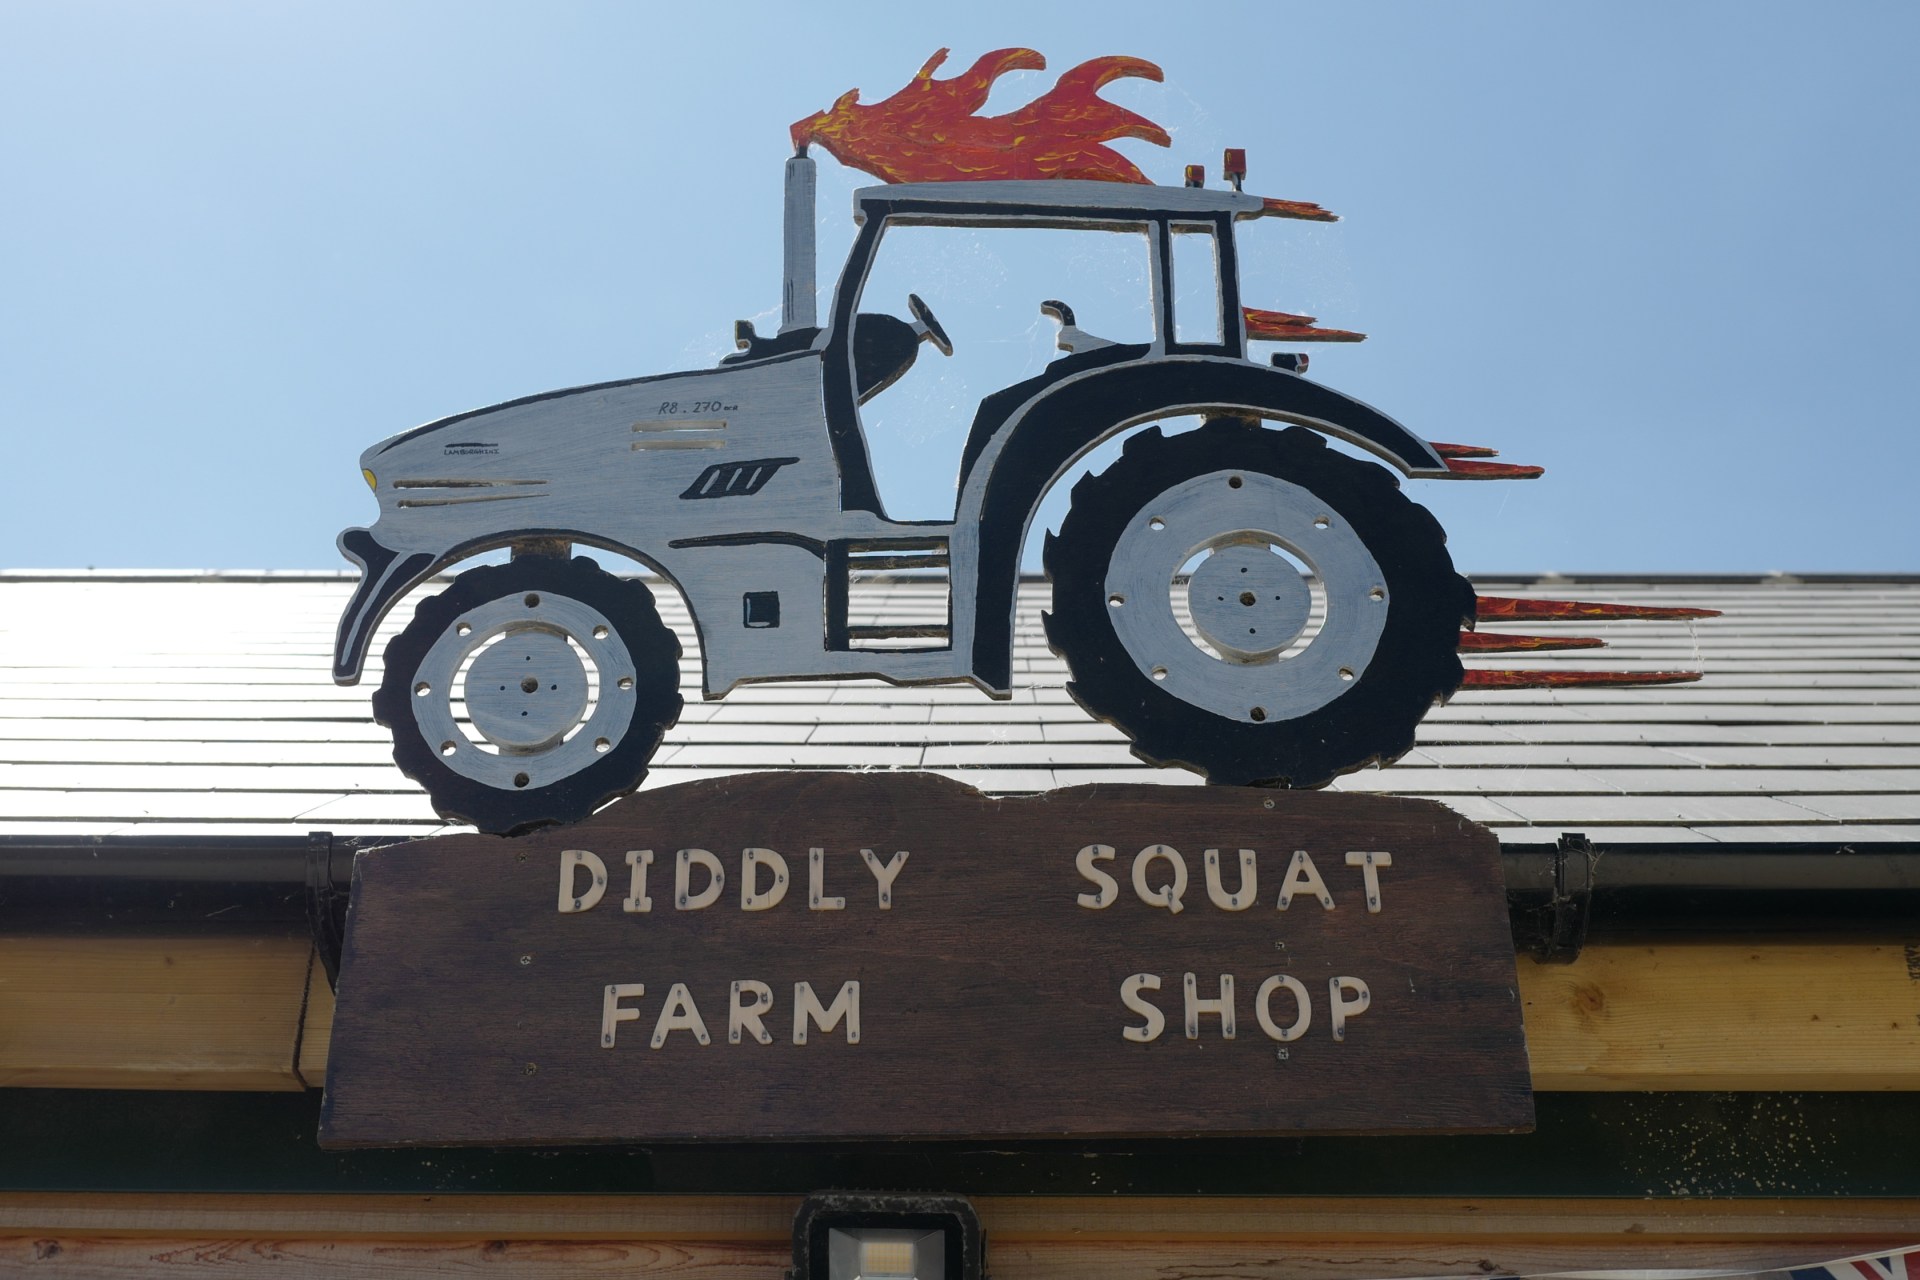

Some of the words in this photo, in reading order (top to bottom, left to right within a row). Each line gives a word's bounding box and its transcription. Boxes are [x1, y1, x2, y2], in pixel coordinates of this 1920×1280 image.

[443, 448, 500, 456] LAMBORGHINI
[558, 847, 910, 913] DIDDLY
[1075, 844, 1392, 914] SQUAT
[601, 979, 860, 1049] FARM
[1120, 972, 1371, 1042] SHOP
